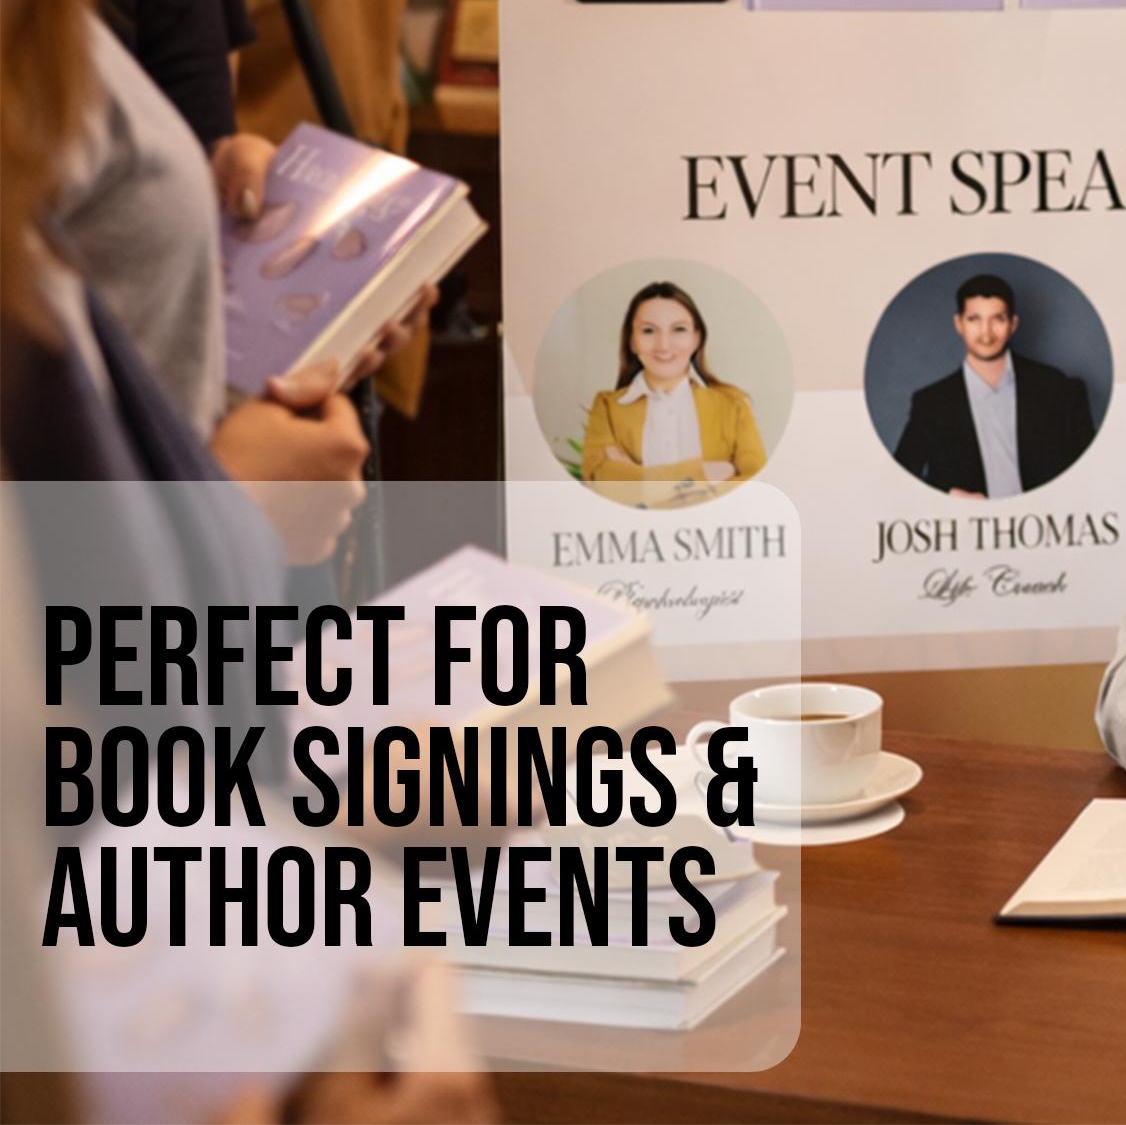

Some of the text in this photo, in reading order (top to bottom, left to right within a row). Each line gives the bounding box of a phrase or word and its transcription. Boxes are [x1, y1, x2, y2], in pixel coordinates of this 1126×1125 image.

[682, 151, 933, 221] EVENT
[551, 524, 787, 568] EMMA SMITH
[872, 512, 1120, 564] JOSH THOMAS
